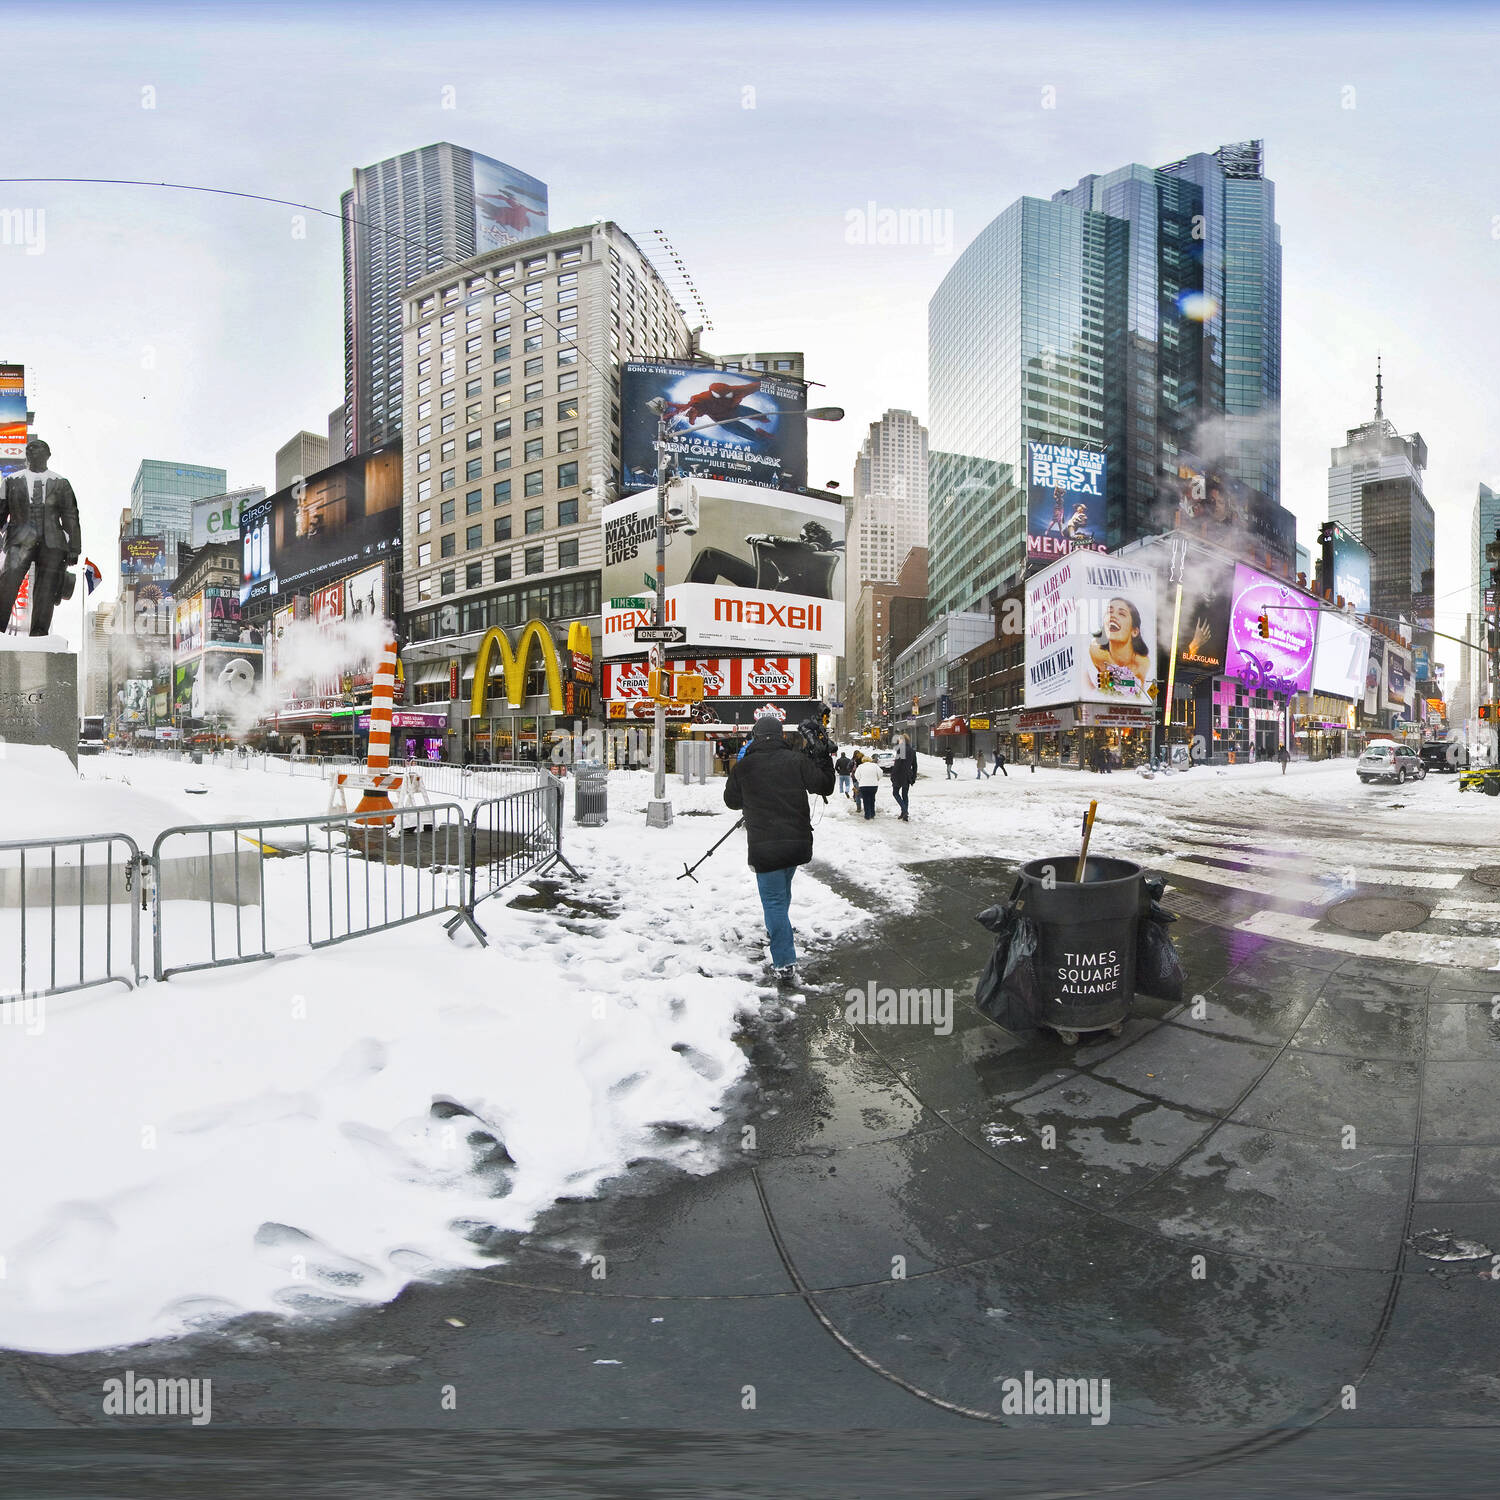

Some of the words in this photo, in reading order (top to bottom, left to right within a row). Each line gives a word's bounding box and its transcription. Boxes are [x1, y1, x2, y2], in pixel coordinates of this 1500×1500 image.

[627, 366, 647, 374] BONO
[655, 367, 668, 375] THE
[776, 386, 799, 397] TAYMOR
[776, 390, 799, 401] BERGER
[672, 435, 751, 452] SPIDER-MAN
[1029, 442, 1105, 464] WINNER!
[691, 445, 717, 457] OFF
[719, 449, 744, 460] THE
[744, 453, 782, 468] DARK
[709, 460, 726, 468] JULIE
[1033, 452, 1053, 462] 2010
[1055, 455, 1075, 466] TONY
[1077, 459, 1103, 471] AWARD
[1032, 460, 1102, 486] BEST
[1032, 476, 1102, 496] MUSICAL
[605, 511, 638, 532] WHERE
[605, 545, 639, 568] LIVES
[280, 571, 309, 585] COUNTDOWN
[316, 563, 328, 571] NEW
[347, 554, 359, 562] EVE
[1086, 566, 1128, 588] MAMMA
[1042, 564, 1072, 597] ALREADY
[613, 598, 635, 608] TIMES
[605, 598, 676, 634] maxll
[714, 597, 822, 632] maxell
[1030, 655, 1056, 686] MAMMA
[1057, 646, 1074, 673] MIA!
[1182, 652, 1220, 666] BLACKGLAMA
[1064, 950, 1117, 966] TIMES
[1057, 964, 1121, 983] SQUARE
[1061, 980, 1118, 994] ALLIANCE
